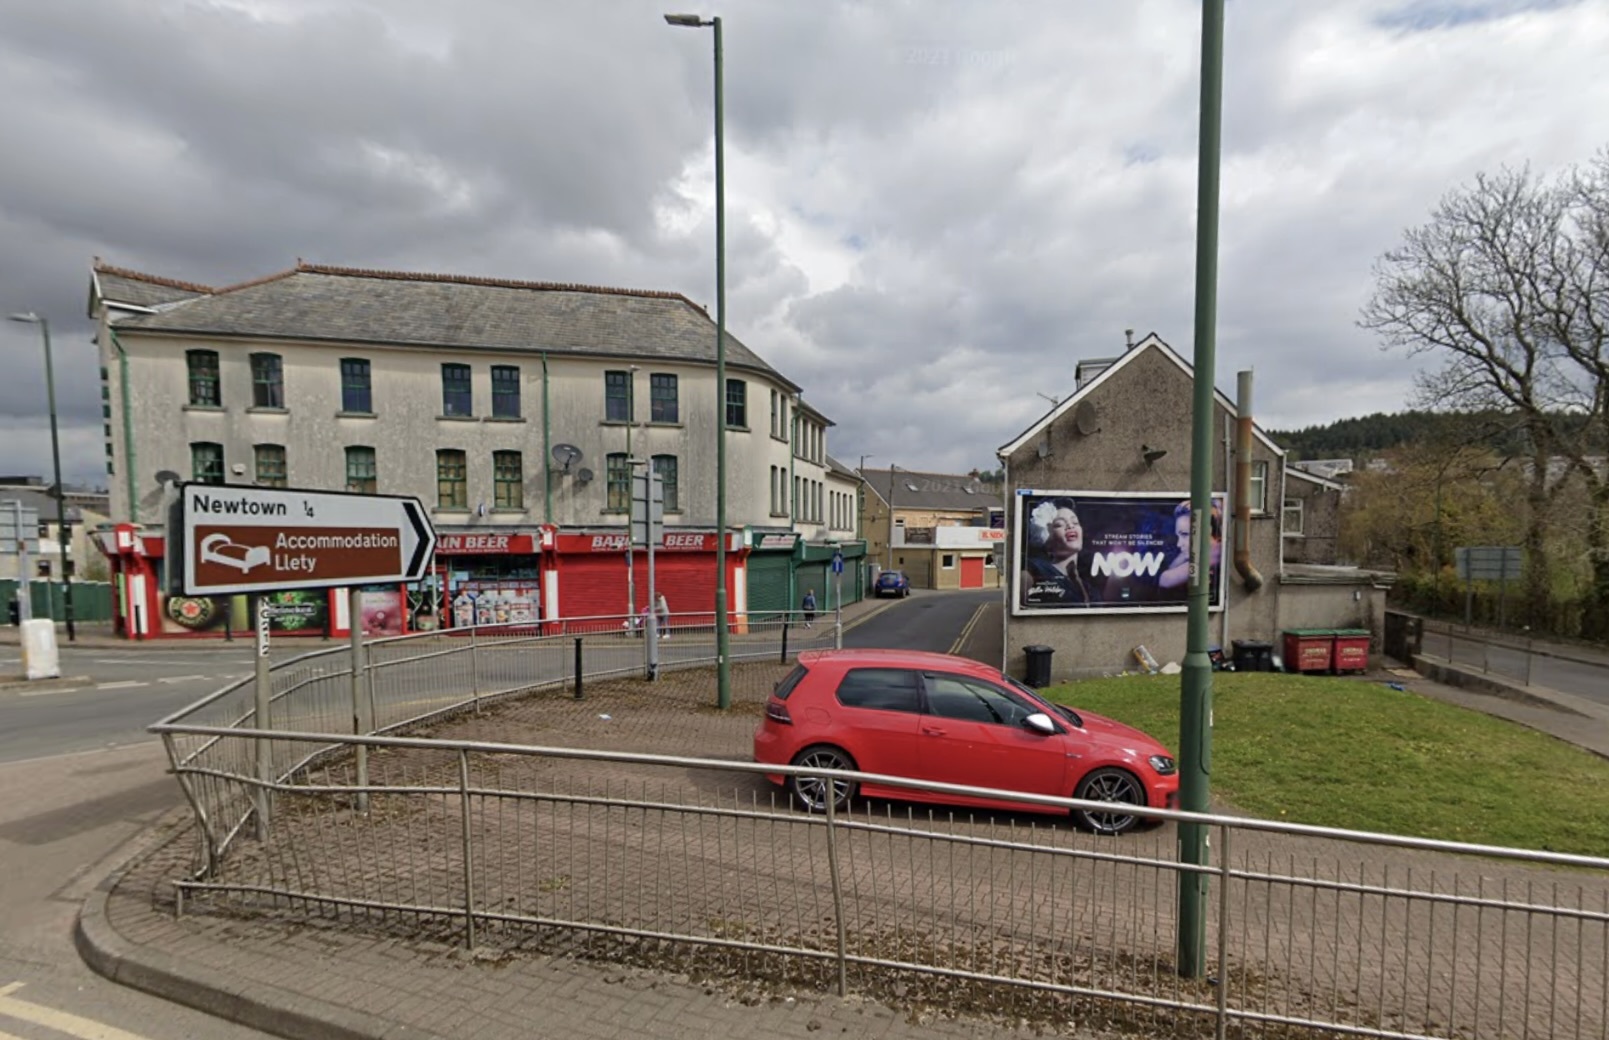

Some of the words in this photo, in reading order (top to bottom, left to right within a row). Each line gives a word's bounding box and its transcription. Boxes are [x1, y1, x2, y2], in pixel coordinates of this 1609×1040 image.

[193, 494, 286, 515] Newtown
[276, 532, 398, 549] Accommodation
[465, 536, 509, 549] BEER
[665, 535, 704, 547] BEER
[275, 554, 316, 573] Llety
[1090, 551, 1165, 577] NOW
